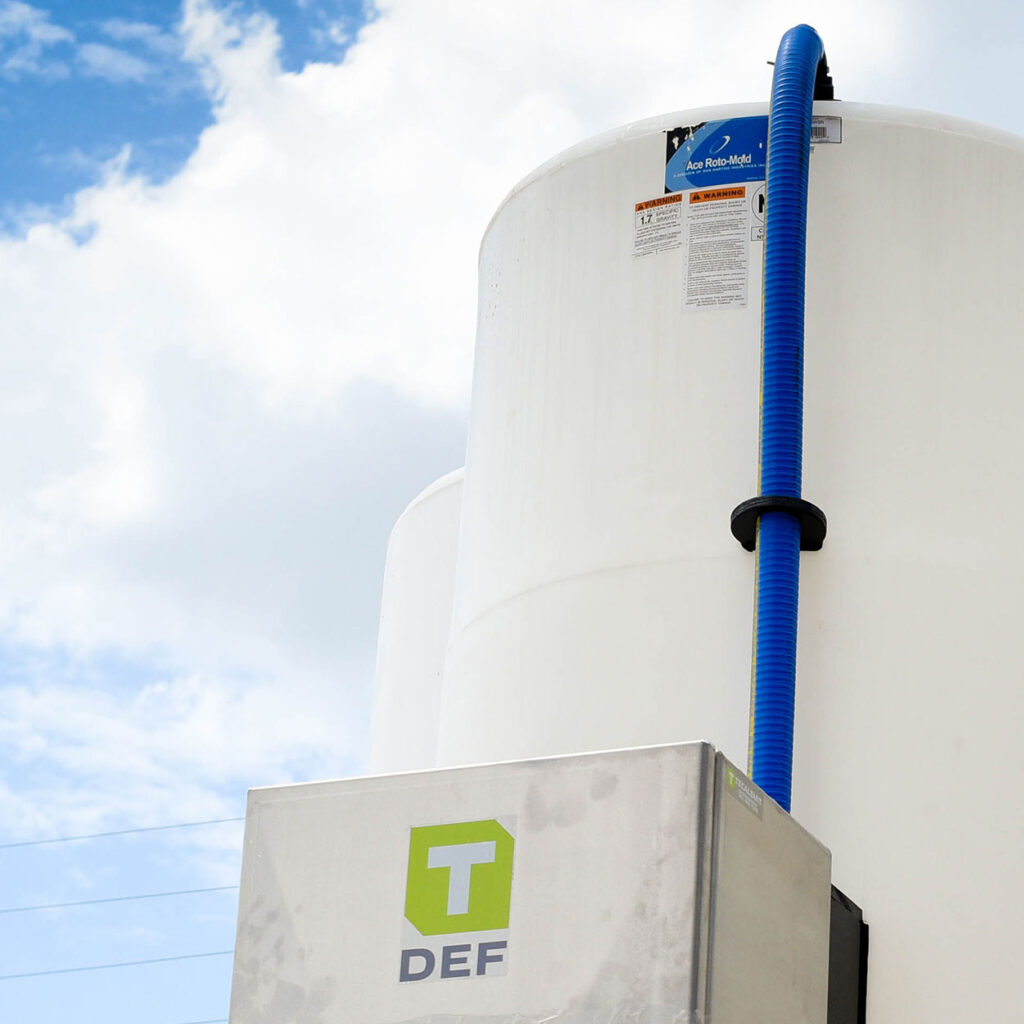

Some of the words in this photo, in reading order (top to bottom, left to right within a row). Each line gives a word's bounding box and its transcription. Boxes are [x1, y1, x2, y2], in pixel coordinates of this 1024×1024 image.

[686, 160, 703, 171] Ace
[705, 154, 752, 168] Roto-Mold
[645, 194, 682, 208] WARNING
[704, 189, 744, 199] WARNING
[640, 214, 653, 225] 1.7
[427, 840, 497, 916] T
[399, 940, 508, 983] DEF
